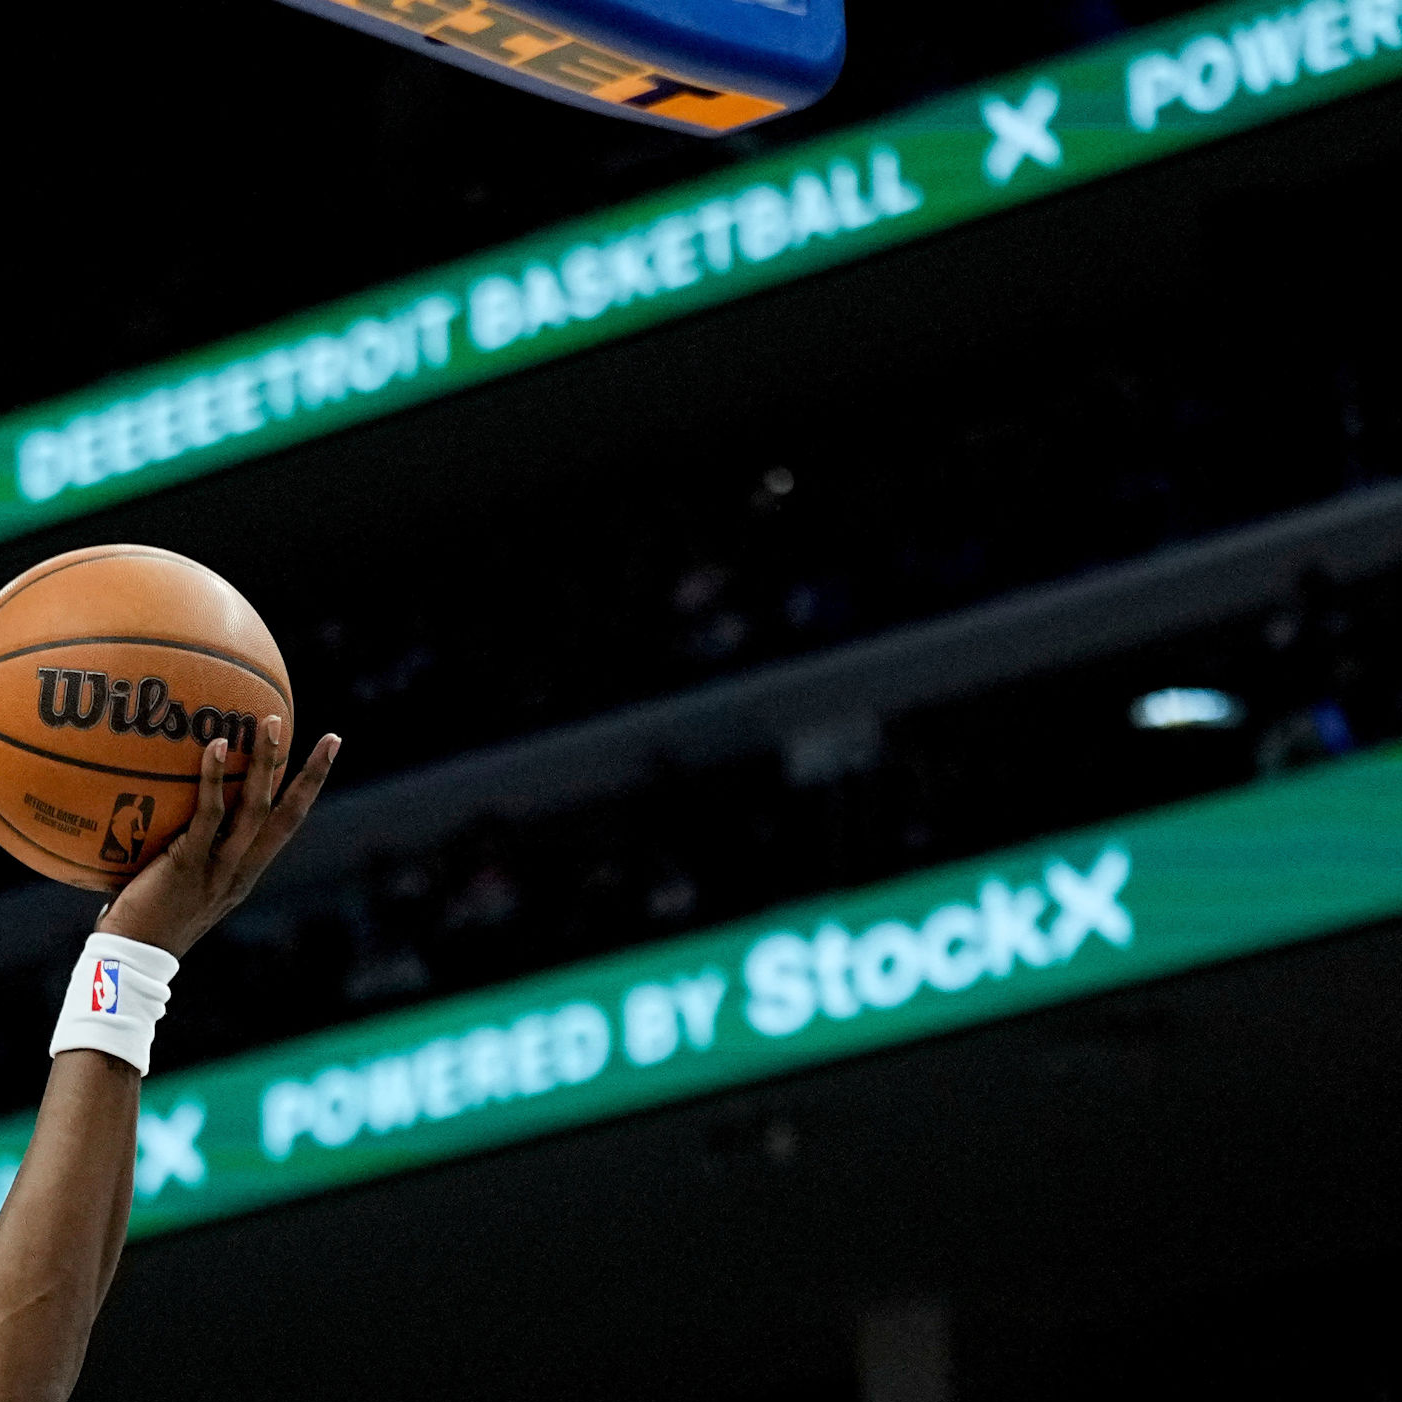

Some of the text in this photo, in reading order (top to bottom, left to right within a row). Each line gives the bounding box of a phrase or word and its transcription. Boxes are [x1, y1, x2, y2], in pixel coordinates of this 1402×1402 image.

[468, 145, 923, 351] BASKETBALL
[1127, 0, 1402, 132] POWER
[37, 667, 258, 755] Wilson
[57, 809, 80, 826] GAME
[260, 1001, 610, 1160] POWERED
[621, 966, 727, 1067] BY
[742, 844, 1133, 1037] StockX
